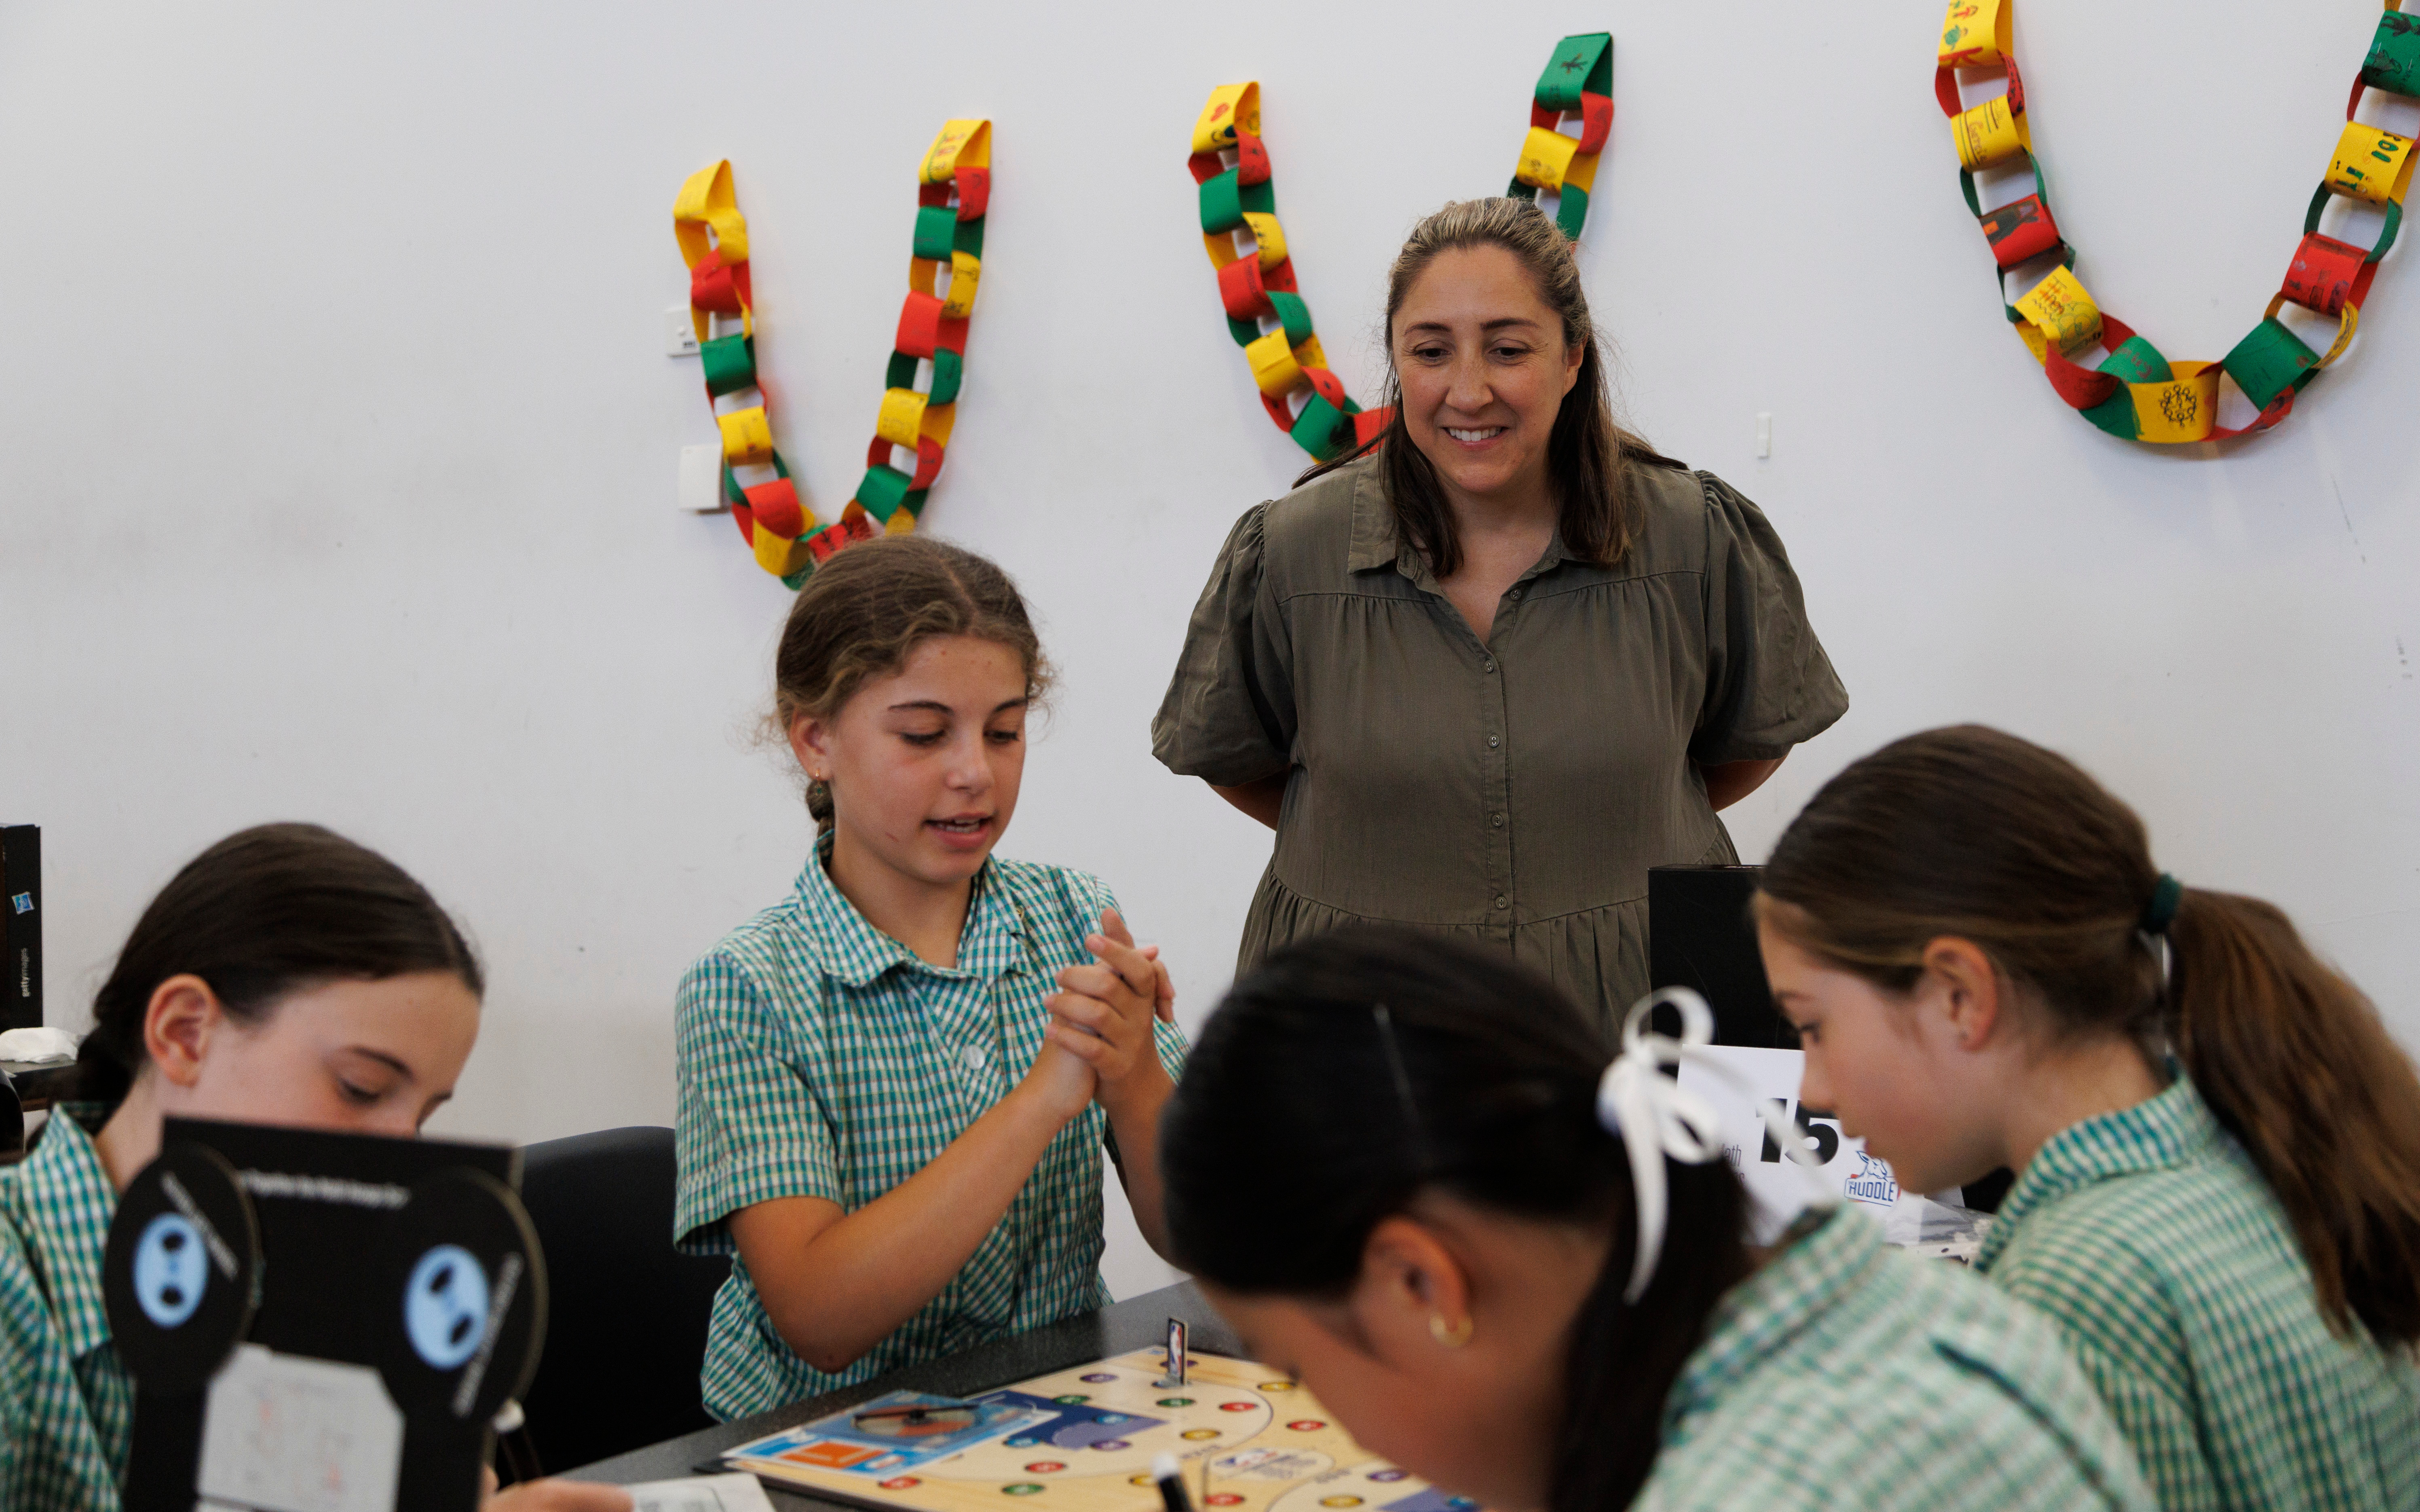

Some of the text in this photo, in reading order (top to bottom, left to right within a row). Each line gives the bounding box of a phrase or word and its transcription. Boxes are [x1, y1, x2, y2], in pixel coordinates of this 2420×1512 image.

[20, 948, 31, 997] gettyimages
[1755, 1097, 1839, 1167] 15
[1721, 1143, 1742, 1167] ath
[1849, 1181, 1896, 1202] HUDDLE
